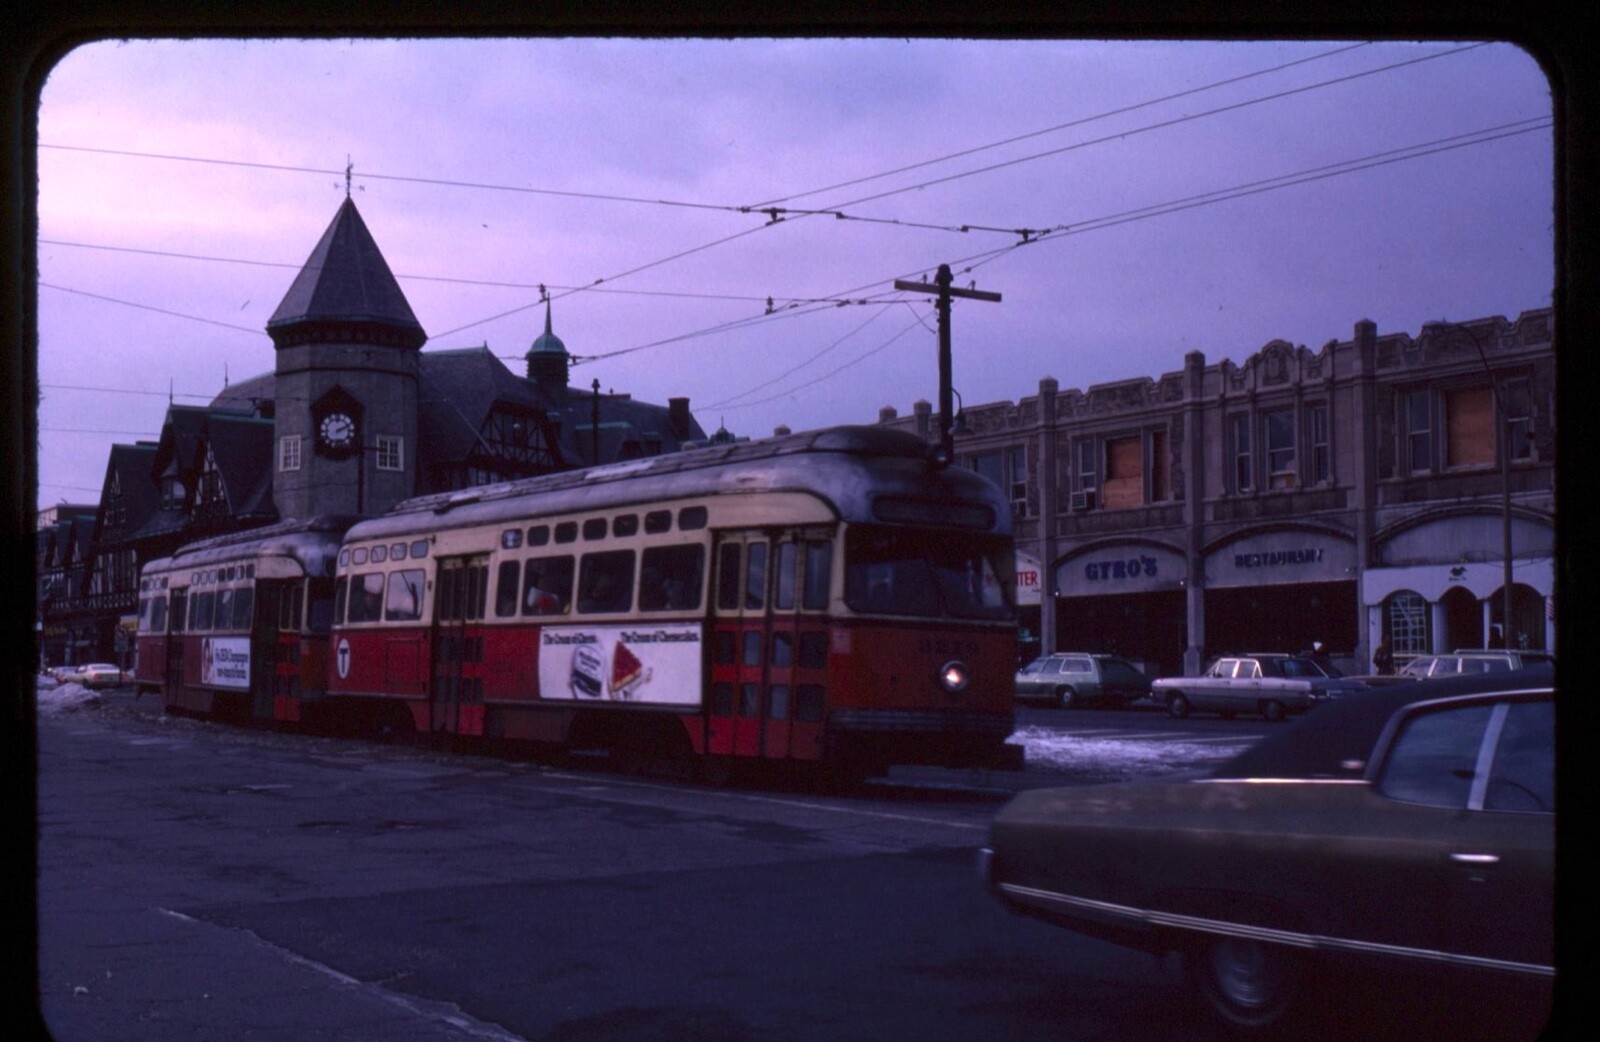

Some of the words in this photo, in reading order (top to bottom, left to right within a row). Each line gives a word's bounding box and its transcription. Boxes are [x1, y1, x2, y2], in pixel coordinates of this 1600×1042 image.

[1085, 554, 1158, 581] GYRO'S
[1235, 548, 1323, 568] RESTAURANT
[1016, 571, 1038, 587] TER
